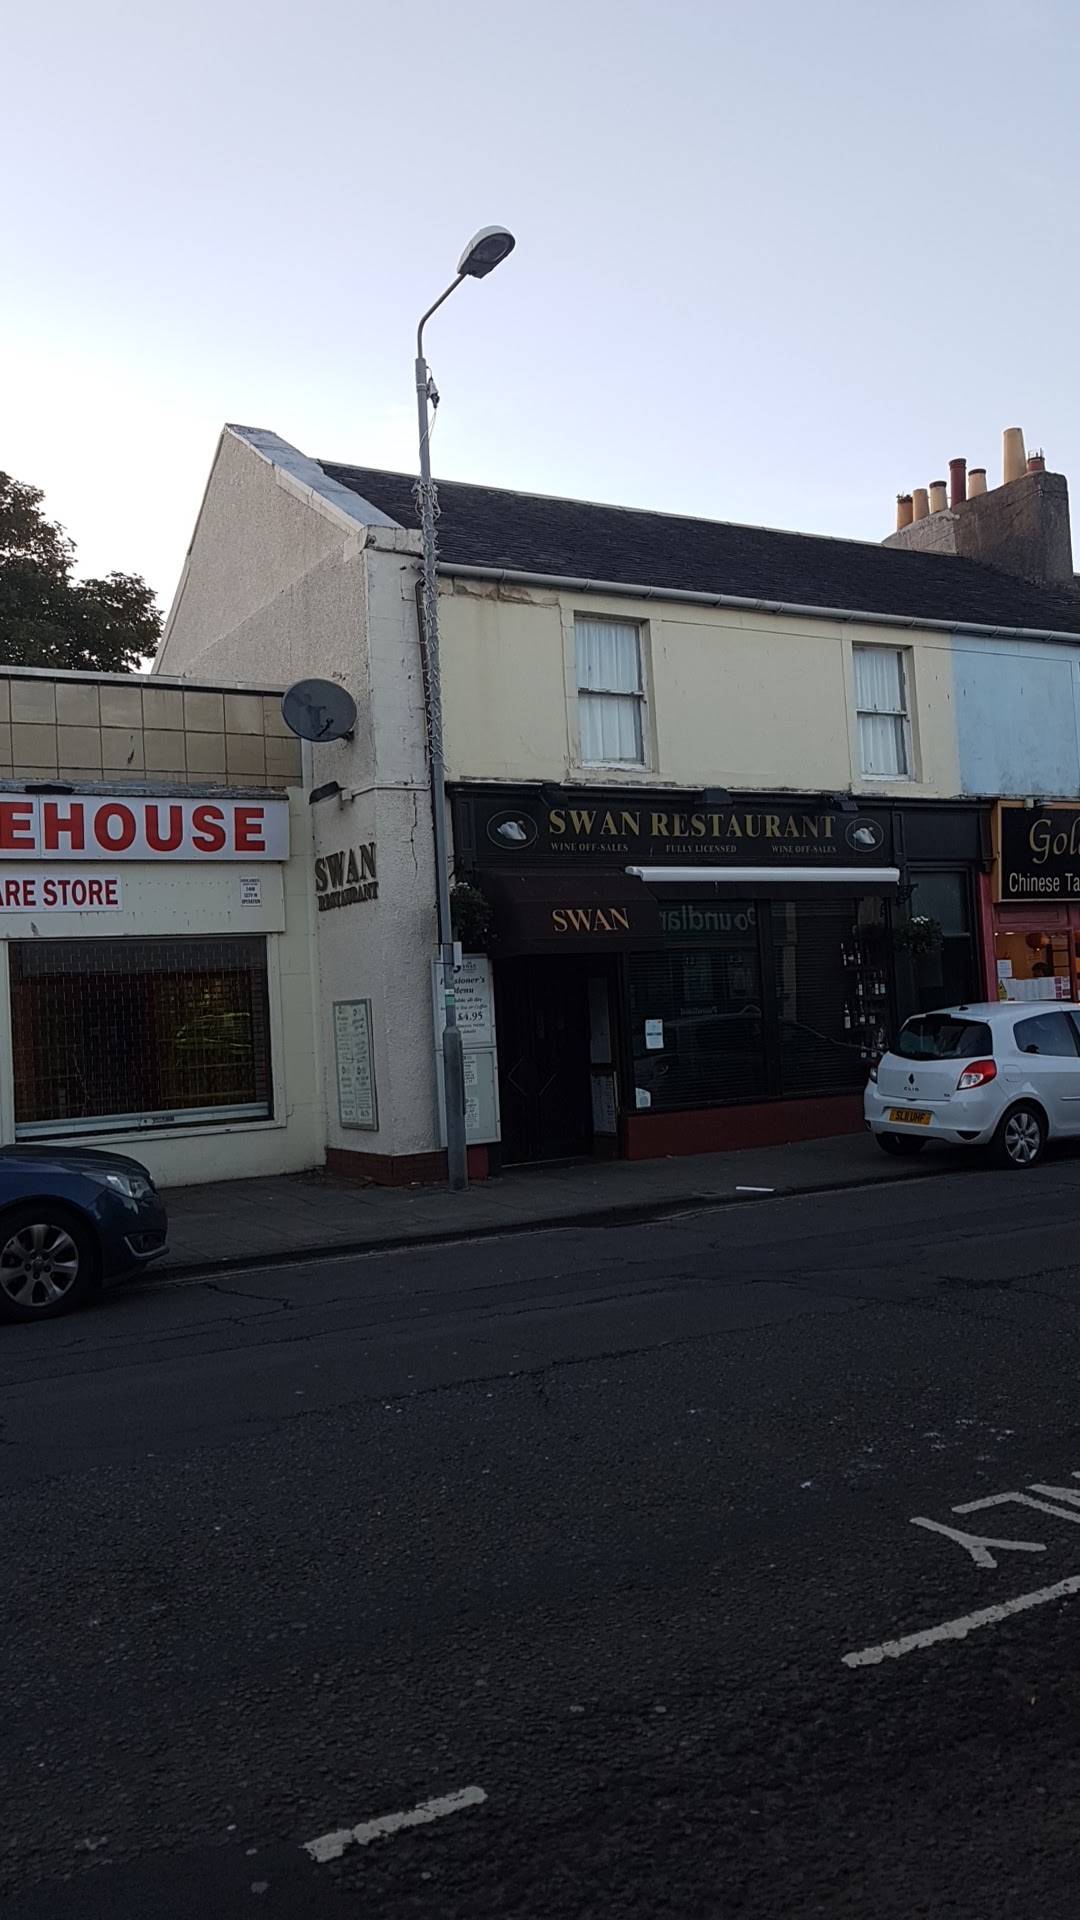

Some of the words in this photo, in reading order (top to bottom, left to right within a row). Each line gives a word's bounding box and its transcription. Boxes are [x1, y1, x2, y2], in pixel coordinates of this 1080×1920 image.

[0, 801, 266, 852] EHOUSE
[548, 808, 641, 837] SWAN
[648, 811, 836, 839] RESTAURANT
[551, 842, 578, 852] WINE
[578, 842, 629, 853] OFF-SALES
[665, 844, 692, 853] FULLY
[695, 845, 737, 854] LICENSED
[771, 845, 794, 854] WINE
[795, 845, 837, 854] OFF-SALES
[1028, 816, 1080, 865] Gol
[314, 841, 377, 891] SWAN
[0, 879, 36, 906] RE
[43, 879, 118, 905] STORE
[317, 881, 379, 911] RESTAURANT
[1009, 872, 1061, 893] Chinese
[551, 907, 632, 932] SWAN
